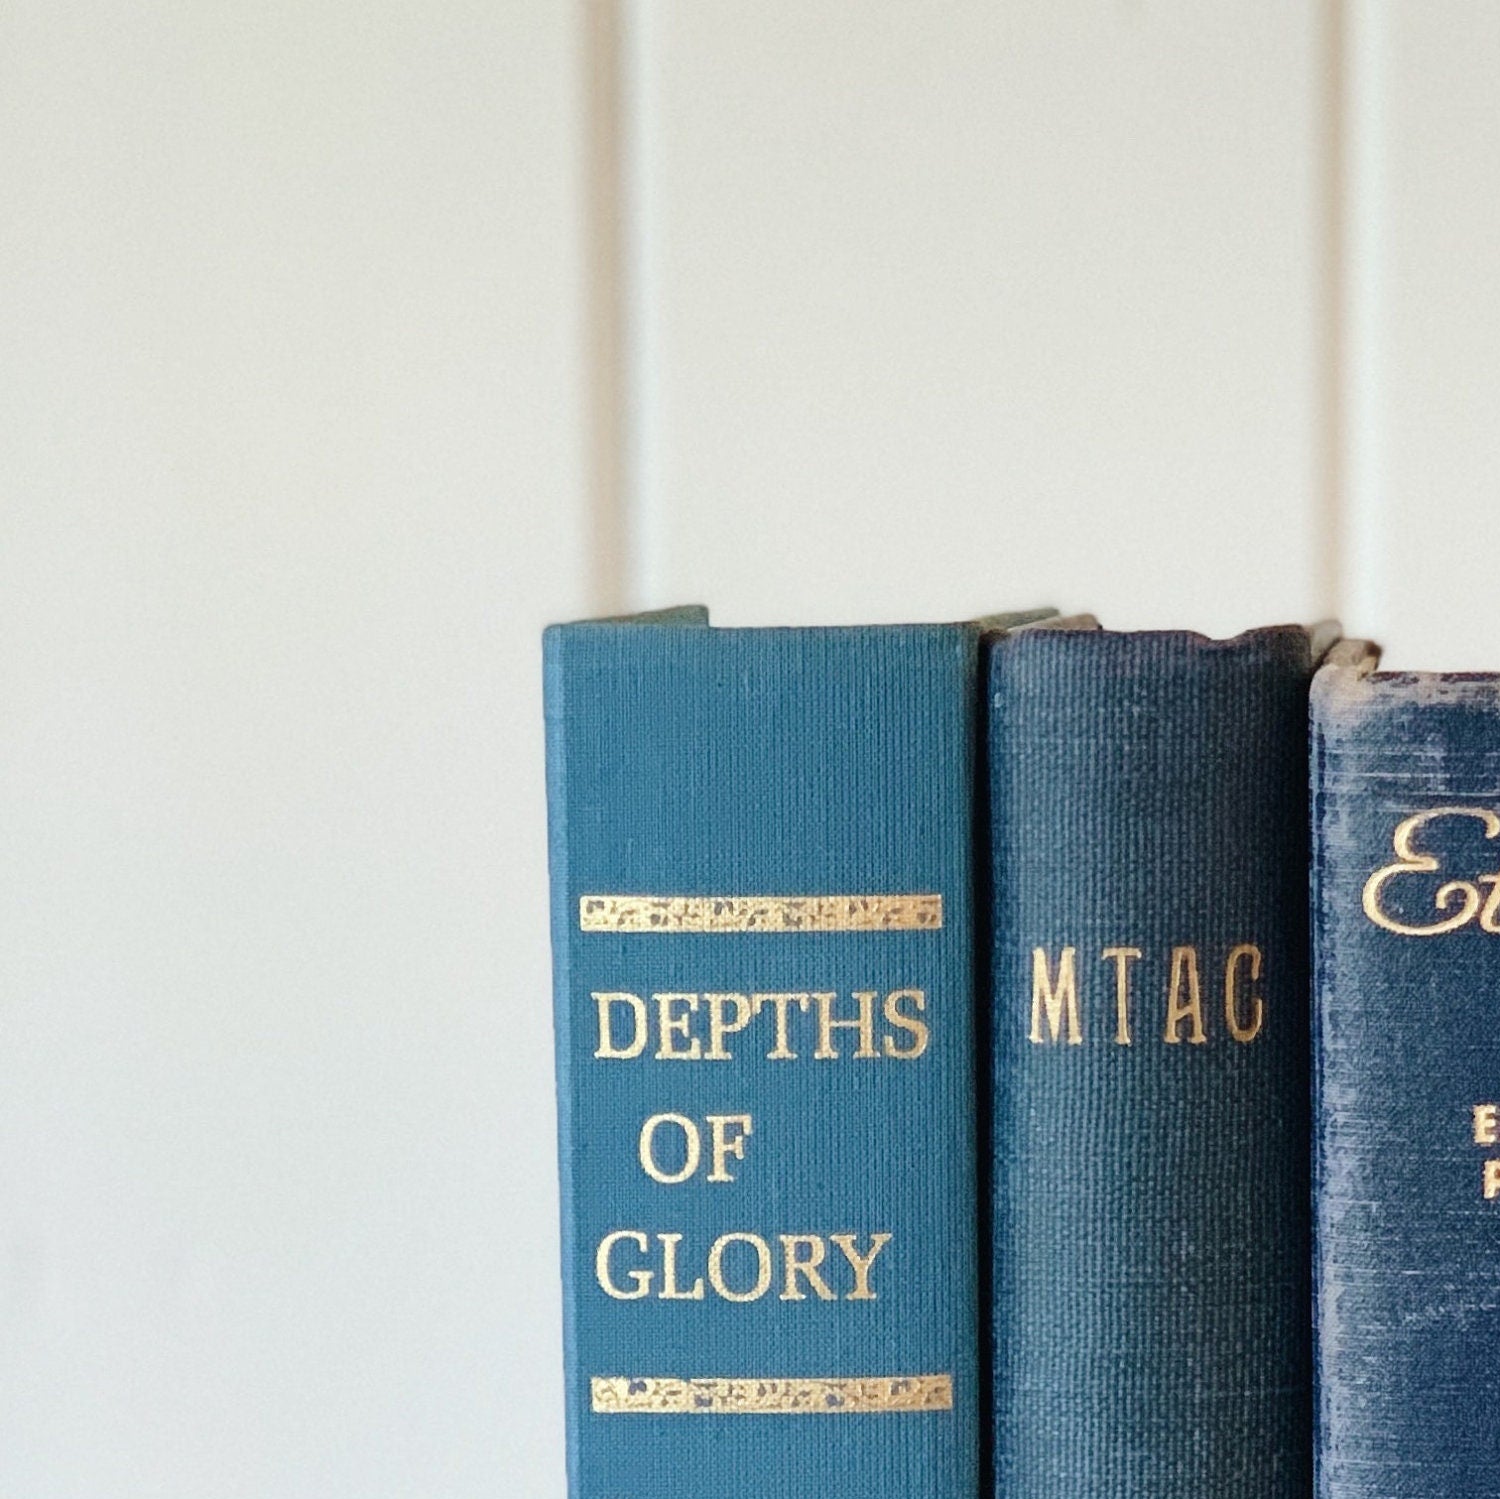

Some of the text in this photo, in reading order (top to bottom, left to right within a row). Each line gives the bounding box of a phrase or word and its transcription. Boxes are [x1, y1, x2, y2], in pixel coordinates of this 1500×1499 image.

[590, 989, 931, 1061] DEPTHS
[638, 1113, 754, 1183] OF
[595, 1230, 894, 1301] GLORY
